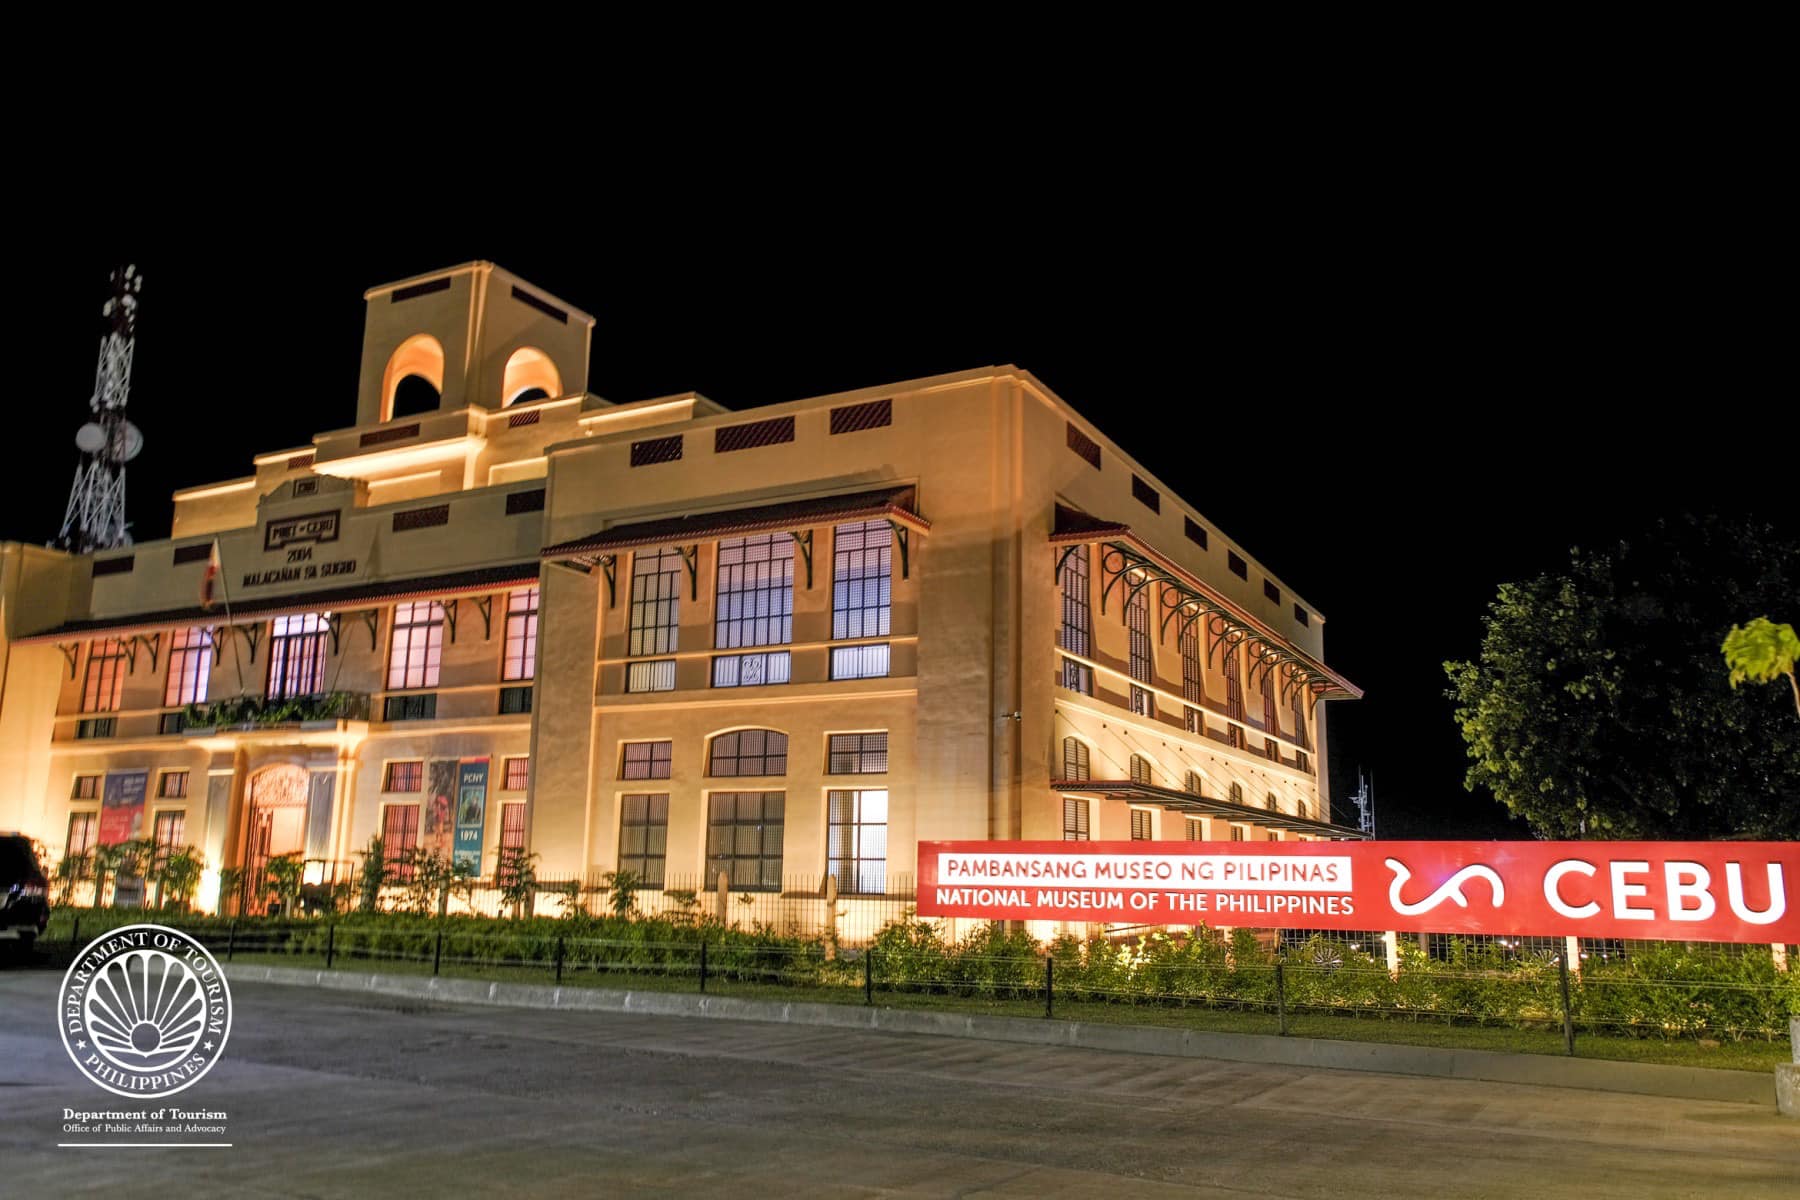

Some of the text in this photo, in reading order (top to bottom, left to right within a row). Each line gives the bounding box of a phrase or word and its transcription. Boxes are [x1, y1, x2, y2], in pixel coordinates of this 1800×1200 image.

[948, 859, 1339, 883] PAMBANSANG MUSEO NG PILIPINAS
[936, 888, 1355, 915] NATIONAL MUSEUM OF THE PHILIPPINES
[1543, 859, 1787, 925] CEBU
